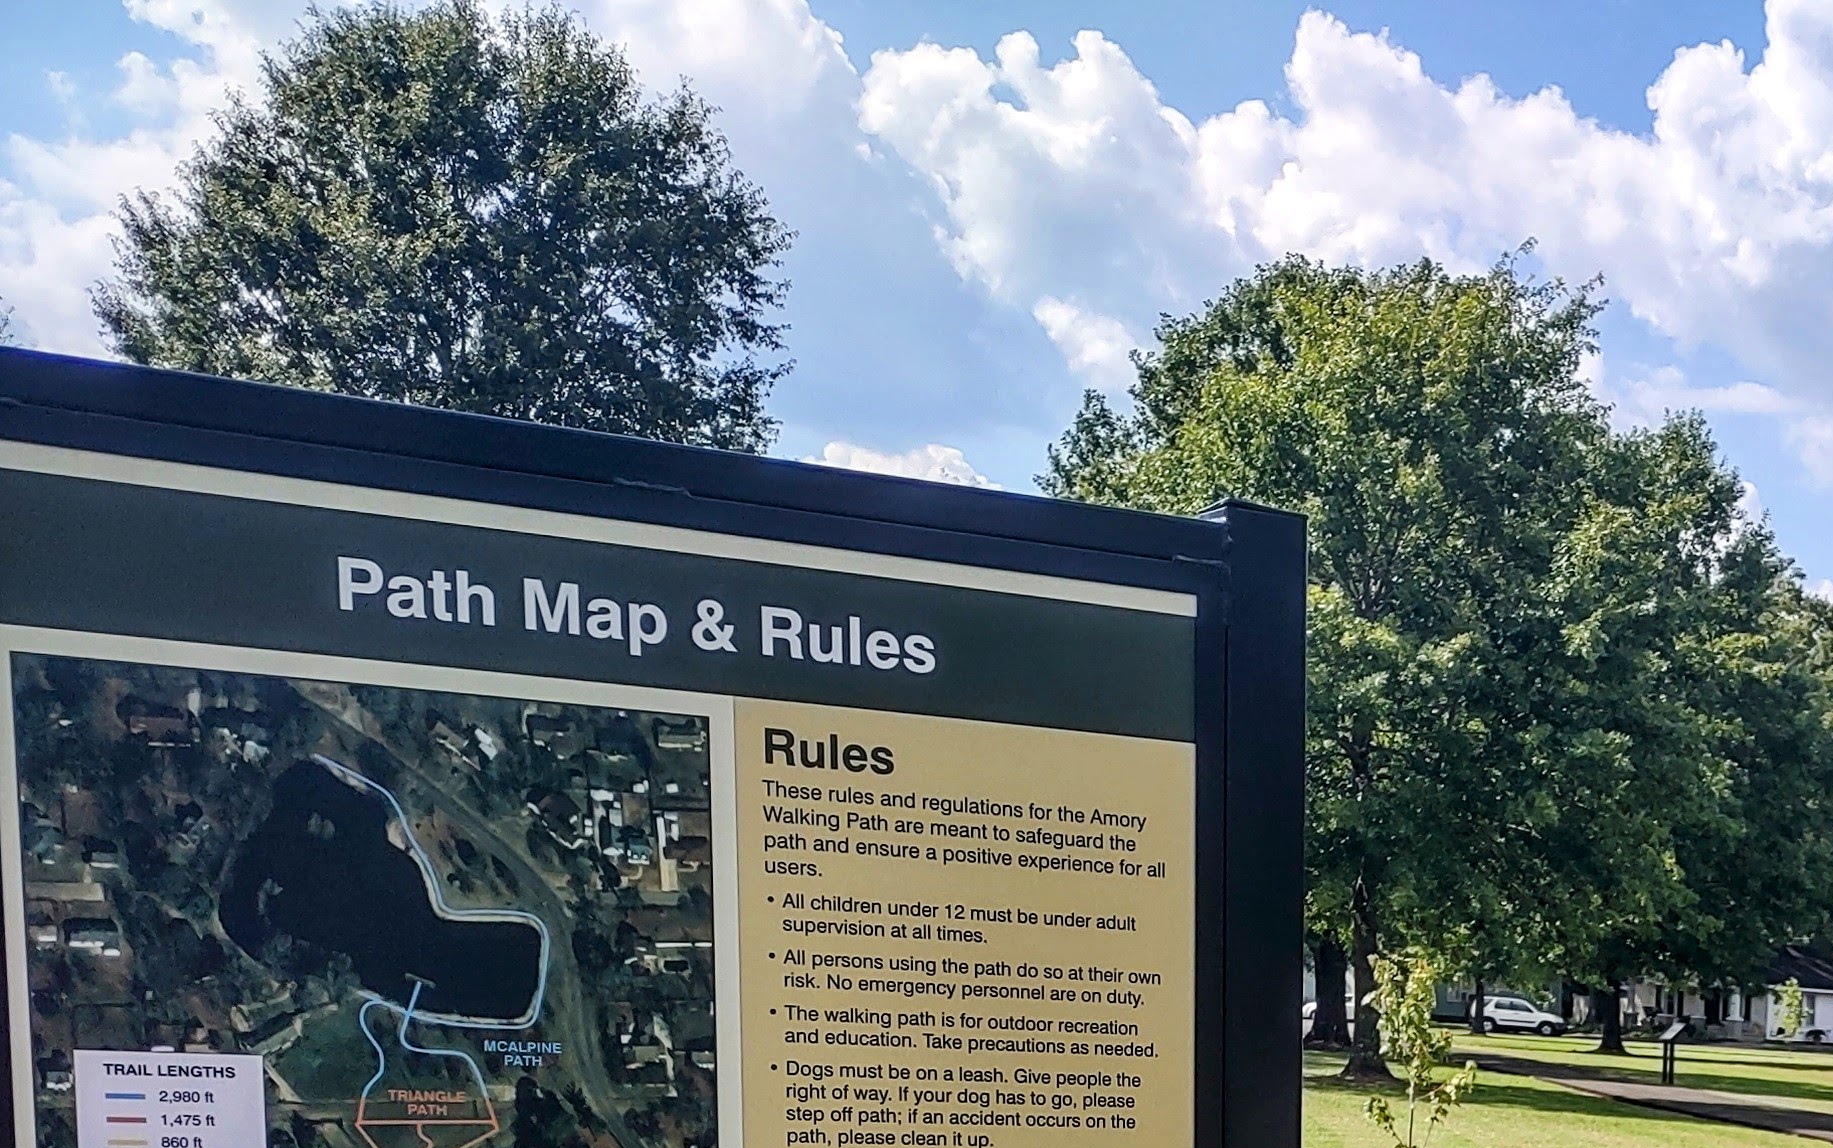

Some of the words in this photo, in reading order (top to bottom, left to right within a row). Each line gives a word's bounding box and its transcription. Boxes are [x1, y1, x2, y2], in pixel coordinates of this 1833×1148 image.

[338, 557, 495, 626] Path
[524, 578, 667, 656] Map
[692, 600, 738, 652] &
[761, 606, 935, 673] Rules
[765, 728, 894, 774] Rules
[762, 780, 822, 800] These
[829, 787, 874, 805] rules
[881, 793, 915, 808] and
[923, 797, 1023, 818] regulations
[1029, 803, 1052, 820] for
[1058, 806, 1084, 823] the
[1090, 809, 1146, 832] Amory
[763, 806, 839, 831] Walking
[847, 812, 888, 831] Path
[895, 820, 924, 834] are
[931, 823, 988, 839] meant
[993, 825, 1010, 841] to
[1016, 828, 1103, 849] safeguard
[1110, 835, 1136, 851] the
[782, 893, 804, 909] All
[811, 895, 881, 914] children
[888, 902, 939, 918] under
[945, 904, 965, 919] 12
[971, 909, 1012, 922] must
[1018, 909, 1038, 924] be
[1044, 912, 1091, 928] under
[1096, 915, 1136, 931] adult
[783, 919, 884, 937] supervision
[891, 924, 907, 938] at
[912, 924, 930, 939] all
[937, 926, 987, 943] times.
[483, 1040, 562, 1053] MCALPINE
[504, 1055, 542, 1067] PATH
[103, 1063, 153, 1076] TRAIL
[158, 1065, 236, 1079] LENGTHS
[159, 1091, 200, 1104] 2,980
[205, 1091, 214, 1103] ft
[388, 1089, 466, 1102] TRIANGLE
[407, 1104, 448, 1116] PATH
[161, 1114, 201, 1127] 1,475
[206, 1114, 215, 1126] ft
[161, 1137, 189, 1148] 860
[193, 1137, 203, 1148] ft
